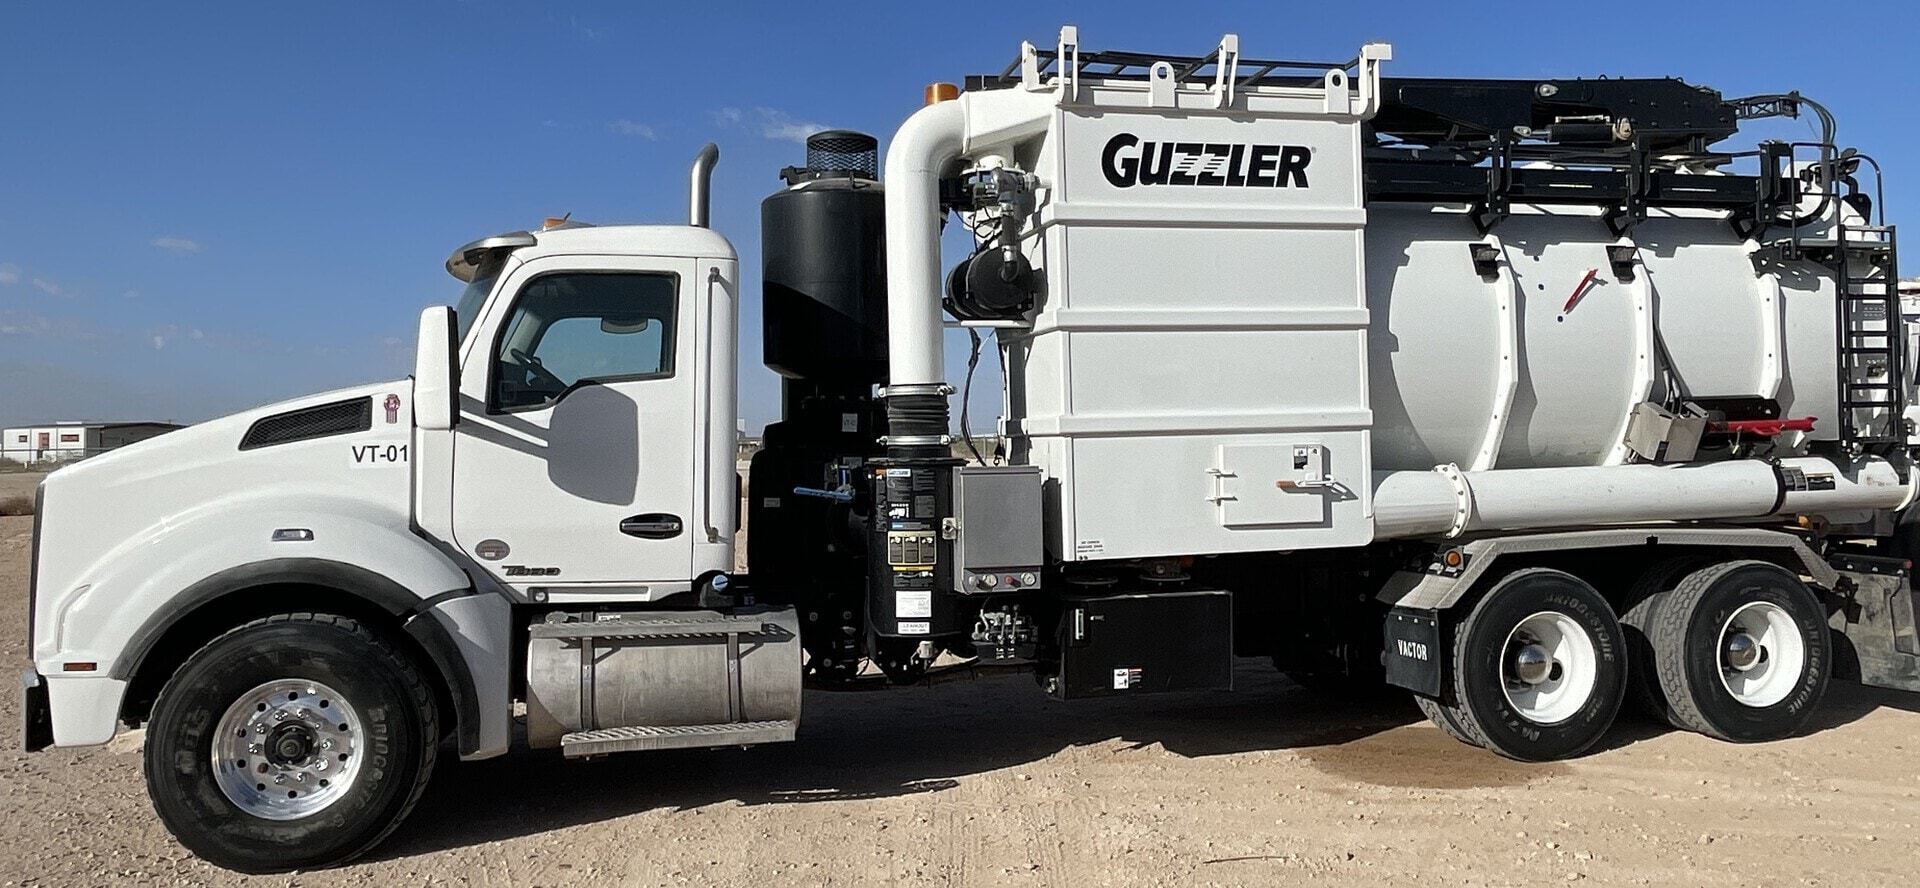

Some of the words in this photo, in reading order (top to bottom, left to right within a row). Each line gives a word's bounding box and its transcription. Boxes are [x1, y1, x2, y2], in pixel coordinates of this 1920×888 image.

[1101, 132, 1312, 188] GUZZLER
[352, 444, 407, 462] VT-01
[1397, 639, 1428, 661] VACTOR
